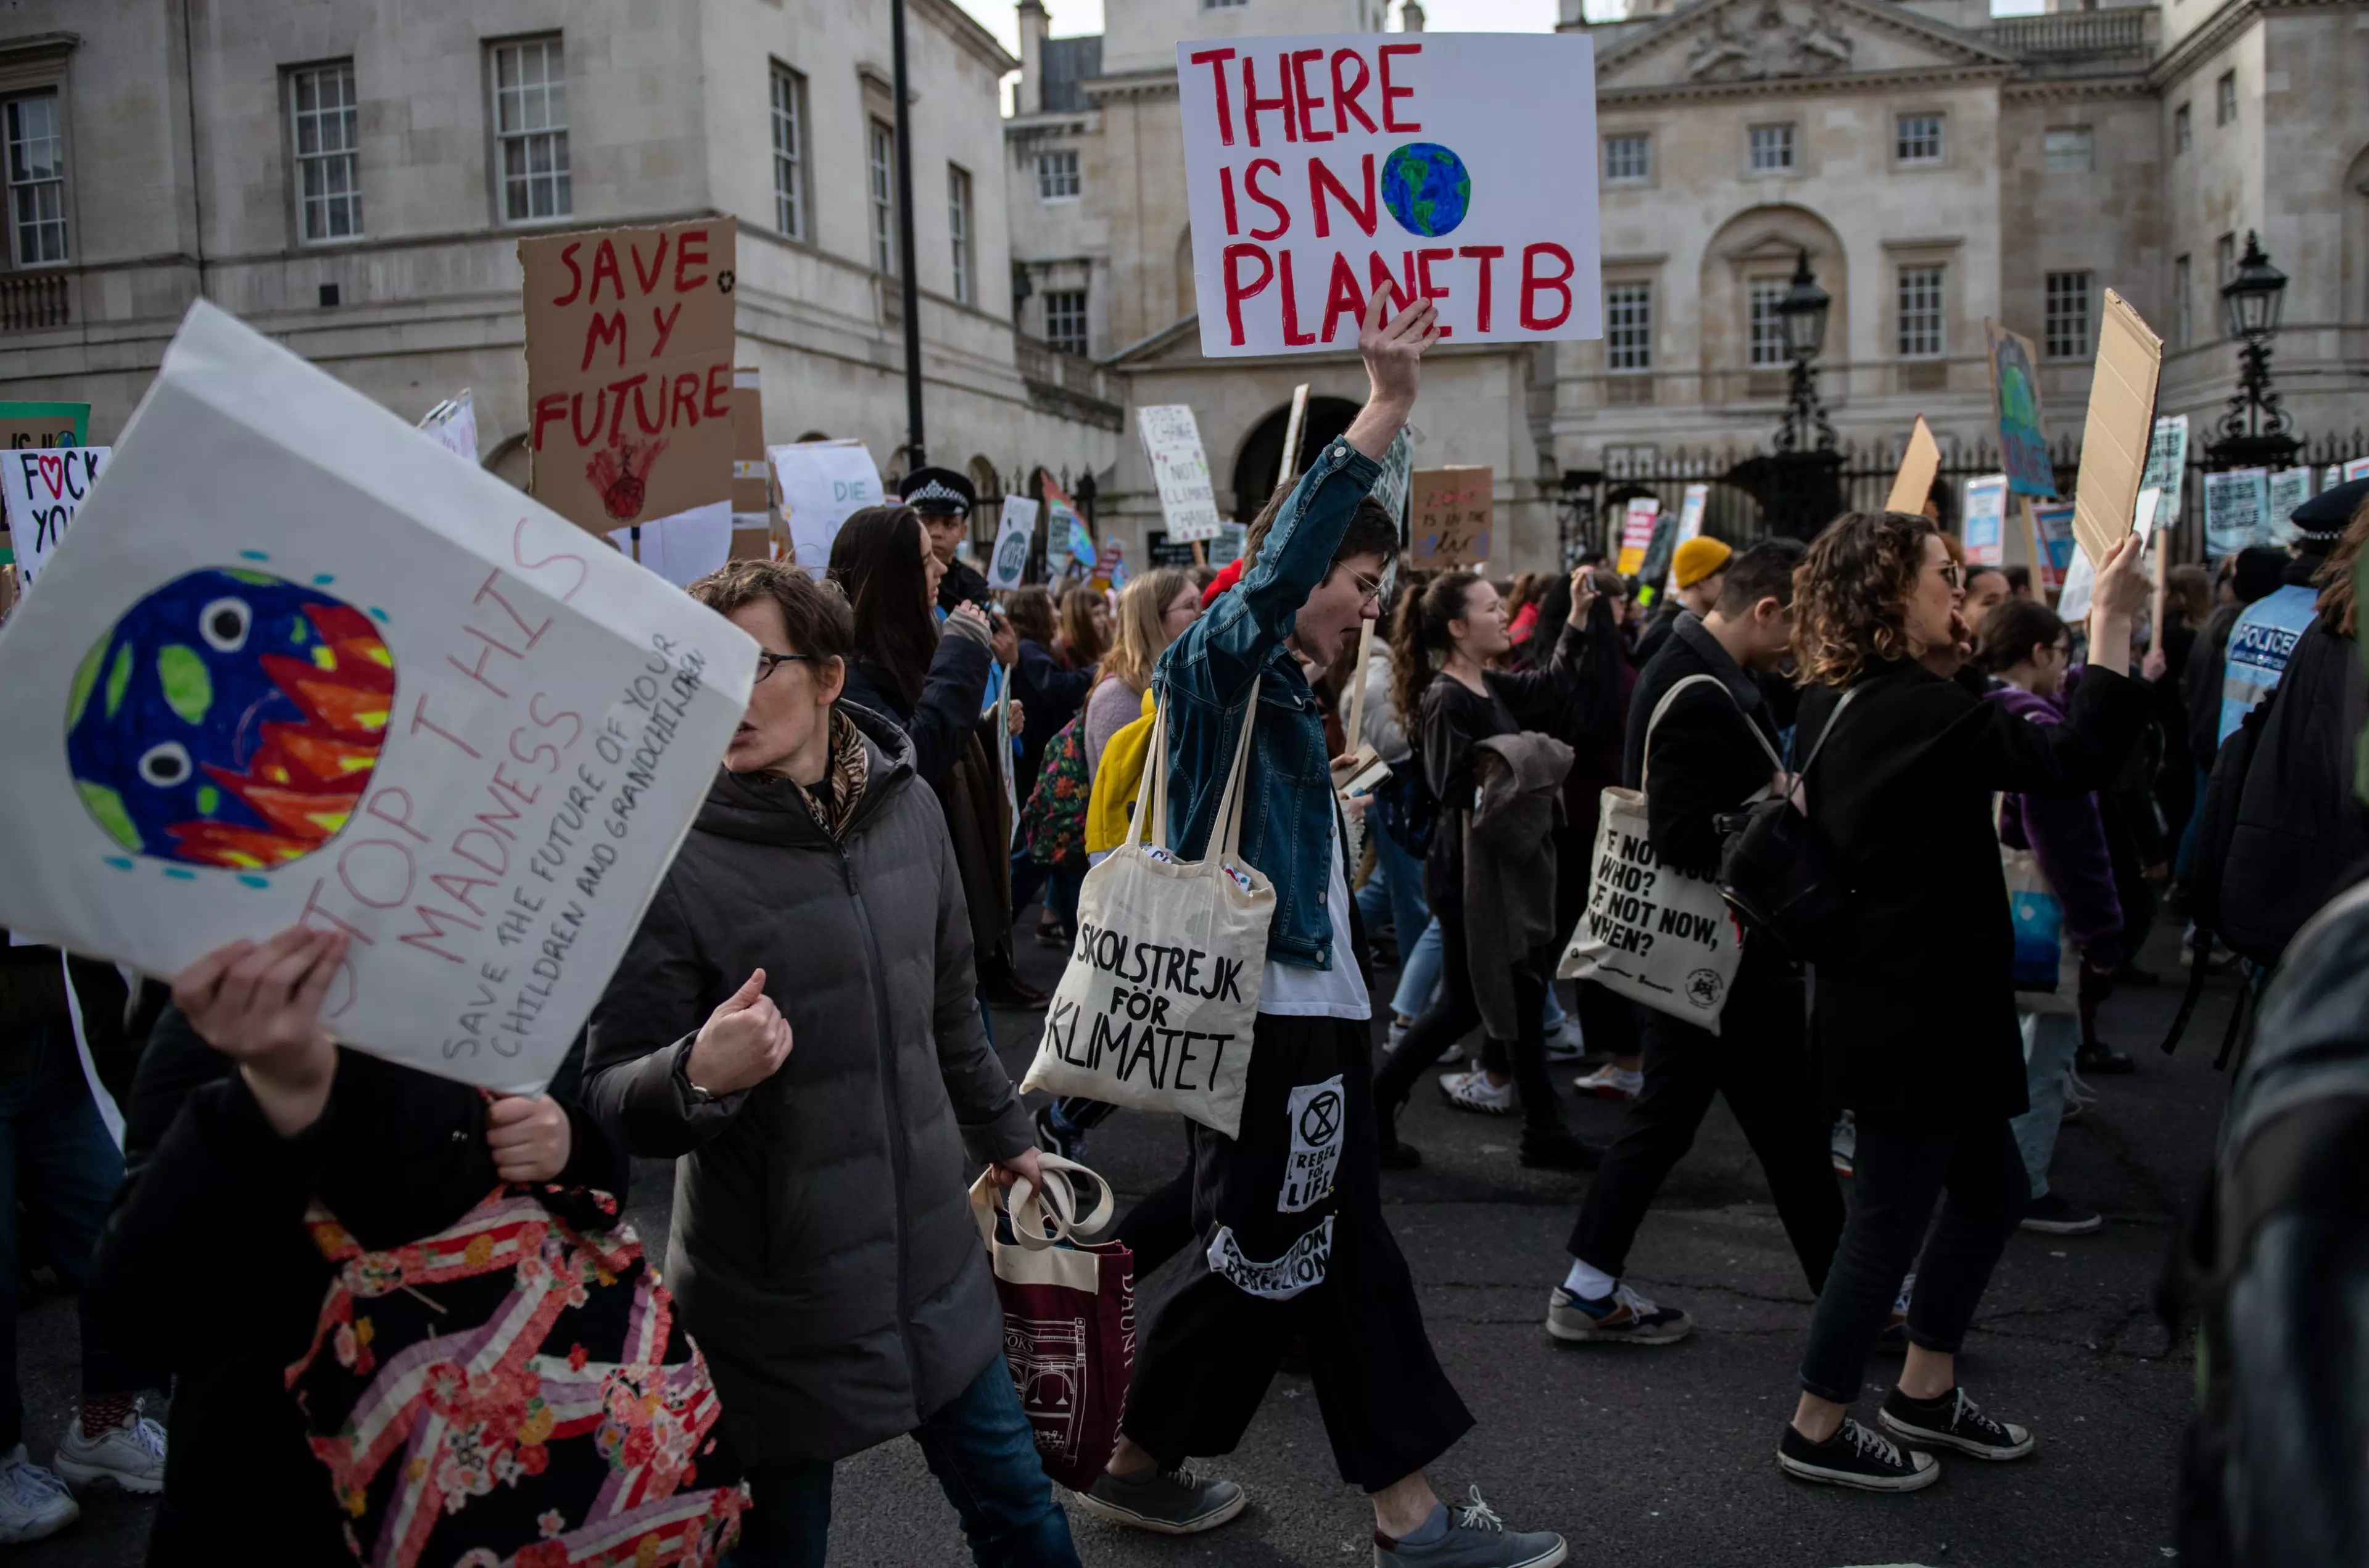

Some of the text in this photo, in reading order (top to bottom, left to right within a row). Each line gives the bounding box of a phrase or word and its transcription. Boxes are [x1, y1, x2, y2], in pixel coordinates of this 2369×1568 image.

[1191, 43, 1422, 148] THERE
[1219, 158, 1291, 241] IS
[552, 229, 709, 307] SAVE
[1223, 242, 1574, 347] PLANET B
[581, 302, 682, 371] MY
[533, 362, 731, 452] FUTURE
[833, 481, 868, 502] DIE
[410, 516, 589, 759] THIS
[2239, 625, 2295, 655] POLICE
[398, 691, 584, 964] MADNESS
[442, 633, 678, 1060] SAVE THE FUTURE OF YOUR
[490, 648, 708, 1058] CHILDREN AND GRANDCHILDREN
[1620, 834, 1661, 870] NO
[1597, 854, 1656, 897] WHO?
[1608, 891, 1657, 928] NOT
[1658, 907, 1719, 953] NOW,
[1077, 922, 1244, 1004] SKOLSTREJK
[1046, 996, 1235, 1092] KLIMATET
[1110, 985, 1170, 1027] FÖR
[1286, 1170, 1330, 1207] LIFE
[1296, 1144, 1336, 1168] REBEL
[1307, 1163, 1325, 1181] FOR
